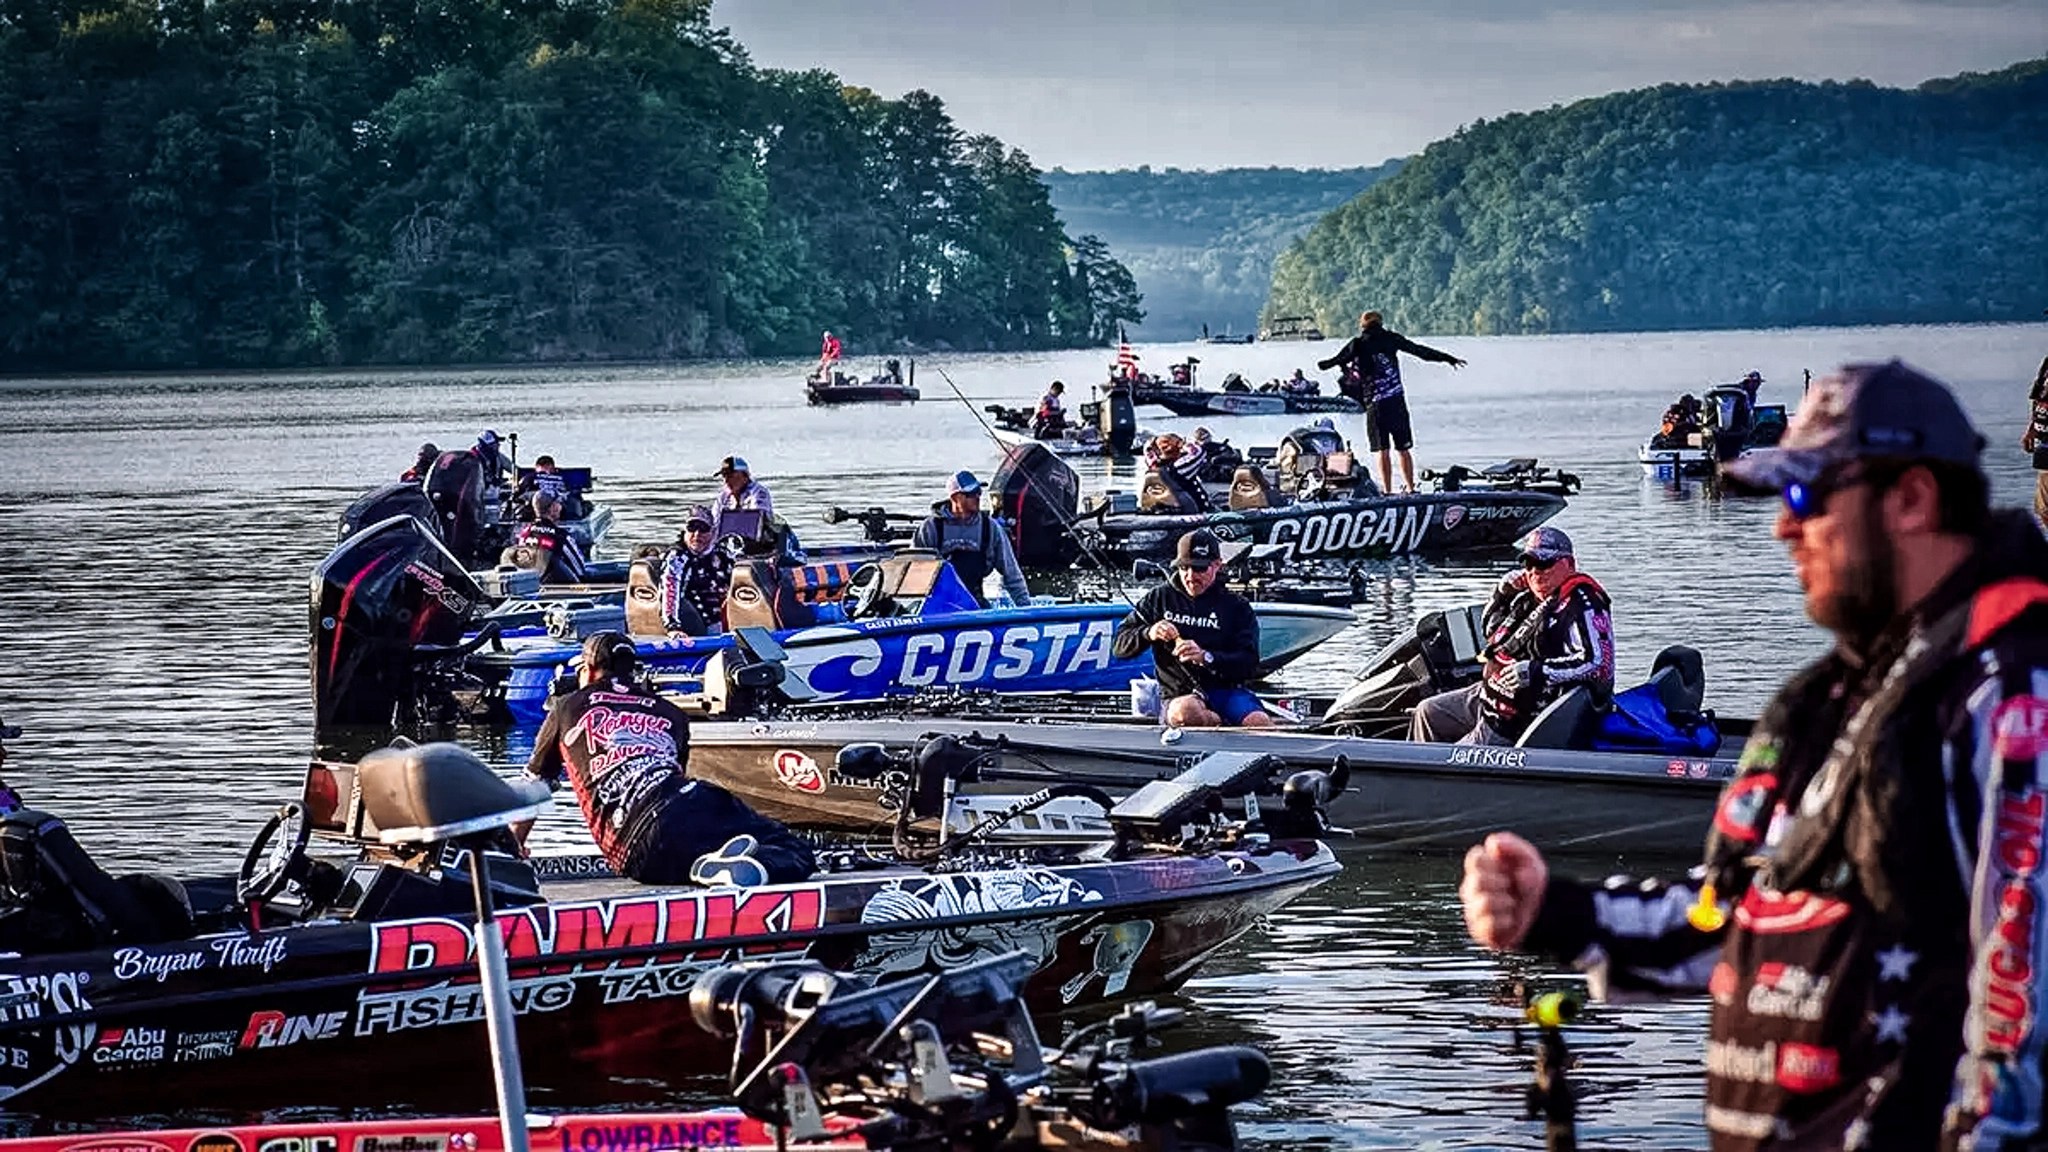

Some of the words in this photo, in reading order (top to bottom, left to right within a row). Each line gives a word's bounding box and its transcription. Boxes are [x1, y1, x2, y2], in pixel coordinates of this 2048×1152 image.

[1268, 504, 1435, 555] GOOGAN
[1164, 610, 1219, 630] GARMIN
[898, 620, 1114, 686] COSTA
[564, 706, 672, 755] Ranger
[1446, 747, 1482, 764] Jeff
[1483, 748, 1526, 768] Kriet
[114, 947, 205, 982] Bryan
[211, 936, 286, 972] Thrift
[363, 884, 827, 988] DAMIKI
[355, 980, 576, 1037] FISHNG
[600, 968, 700, 1004] TAC
[93, 1044, 164, 1064] Garcia
[121, 1028, 167, 1047] Abu
[561, 1118, 742, 1152] LOWRANCE
